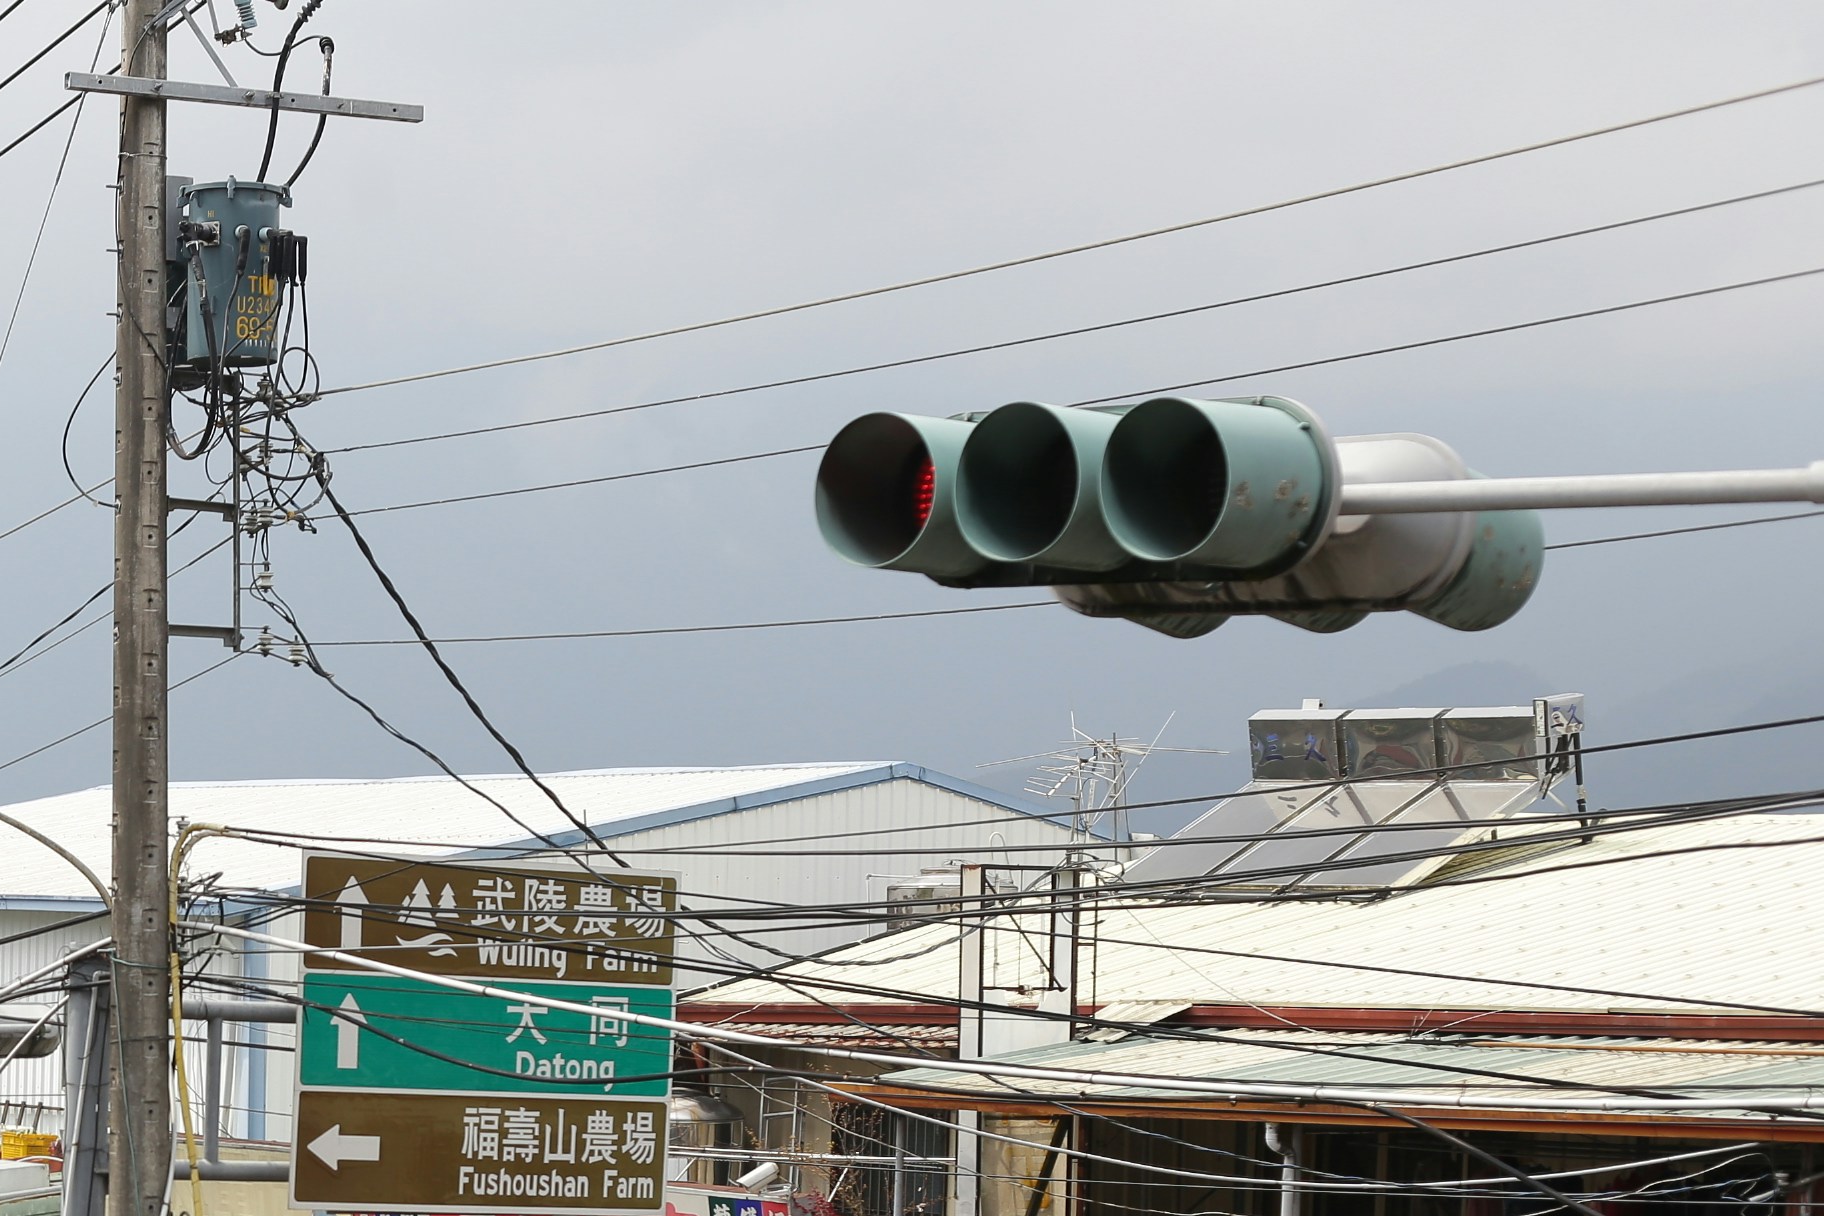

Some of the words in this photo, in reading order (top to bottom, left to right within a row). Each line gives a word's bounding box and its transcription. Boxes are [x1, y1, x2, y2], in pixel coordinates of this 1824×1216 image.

[470, 876, 667, 938] 武陵農場
[476, 936, 568, 979] Wuling
[586, 940, 659, 974] Farm
[505, 992, 630, 1048] 大同
[515, 1050, 615, 1092] Datong
[460, 1106, 657, 1166] 福壽山農場
[458, 1165, 589, 1199] Fushoushan
[602, 1169, 655, 1199] Farm
